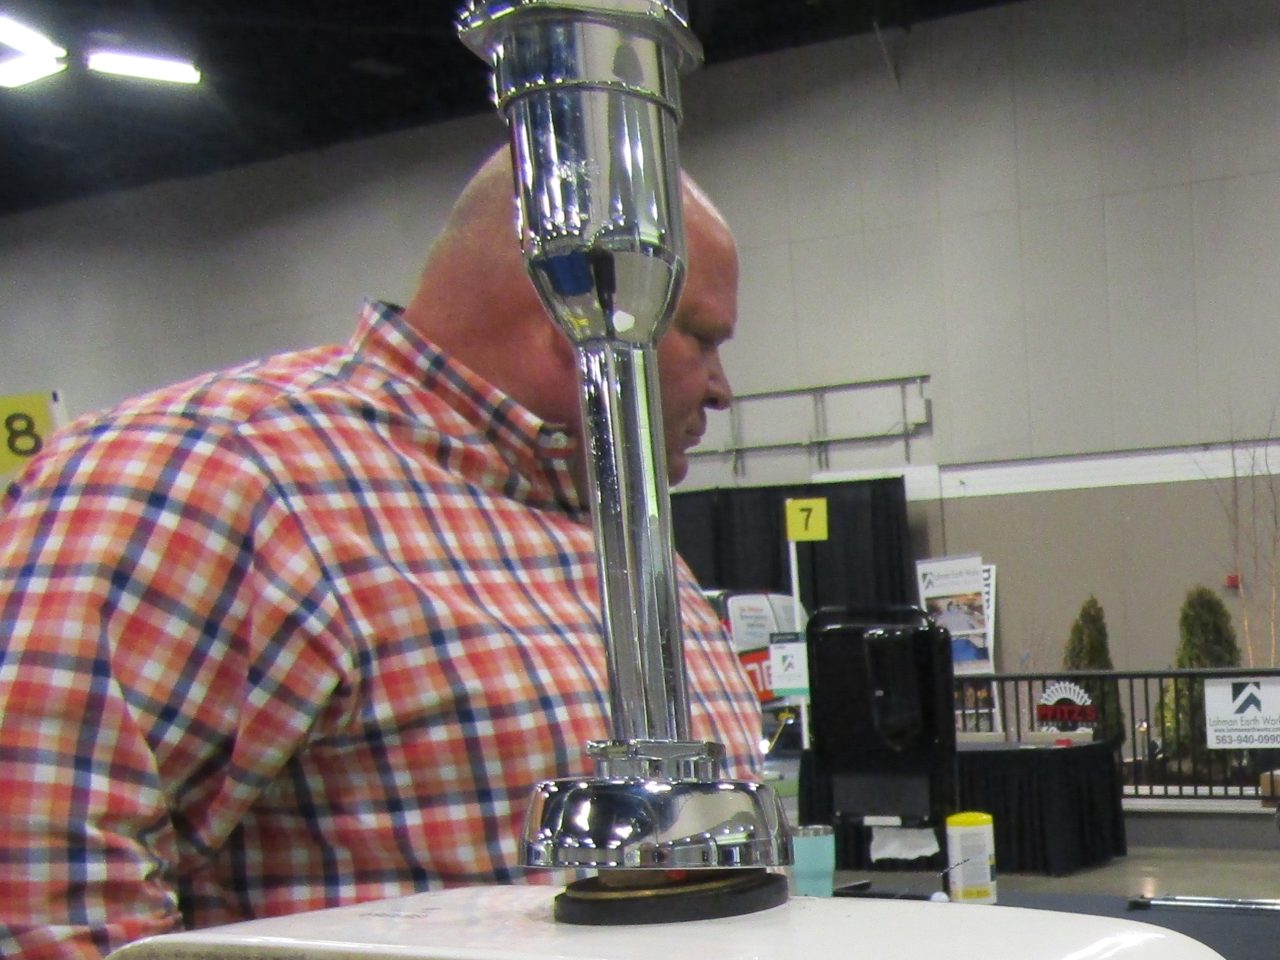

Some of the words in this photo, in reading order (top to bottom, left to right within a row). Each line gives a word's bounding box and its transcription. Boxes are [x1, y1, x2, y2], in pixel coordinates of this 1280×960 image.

[5, 412, 42, 457] 8
[799, 508, 812, 531] 7
[1240, 715, 1260, 726] Earth
